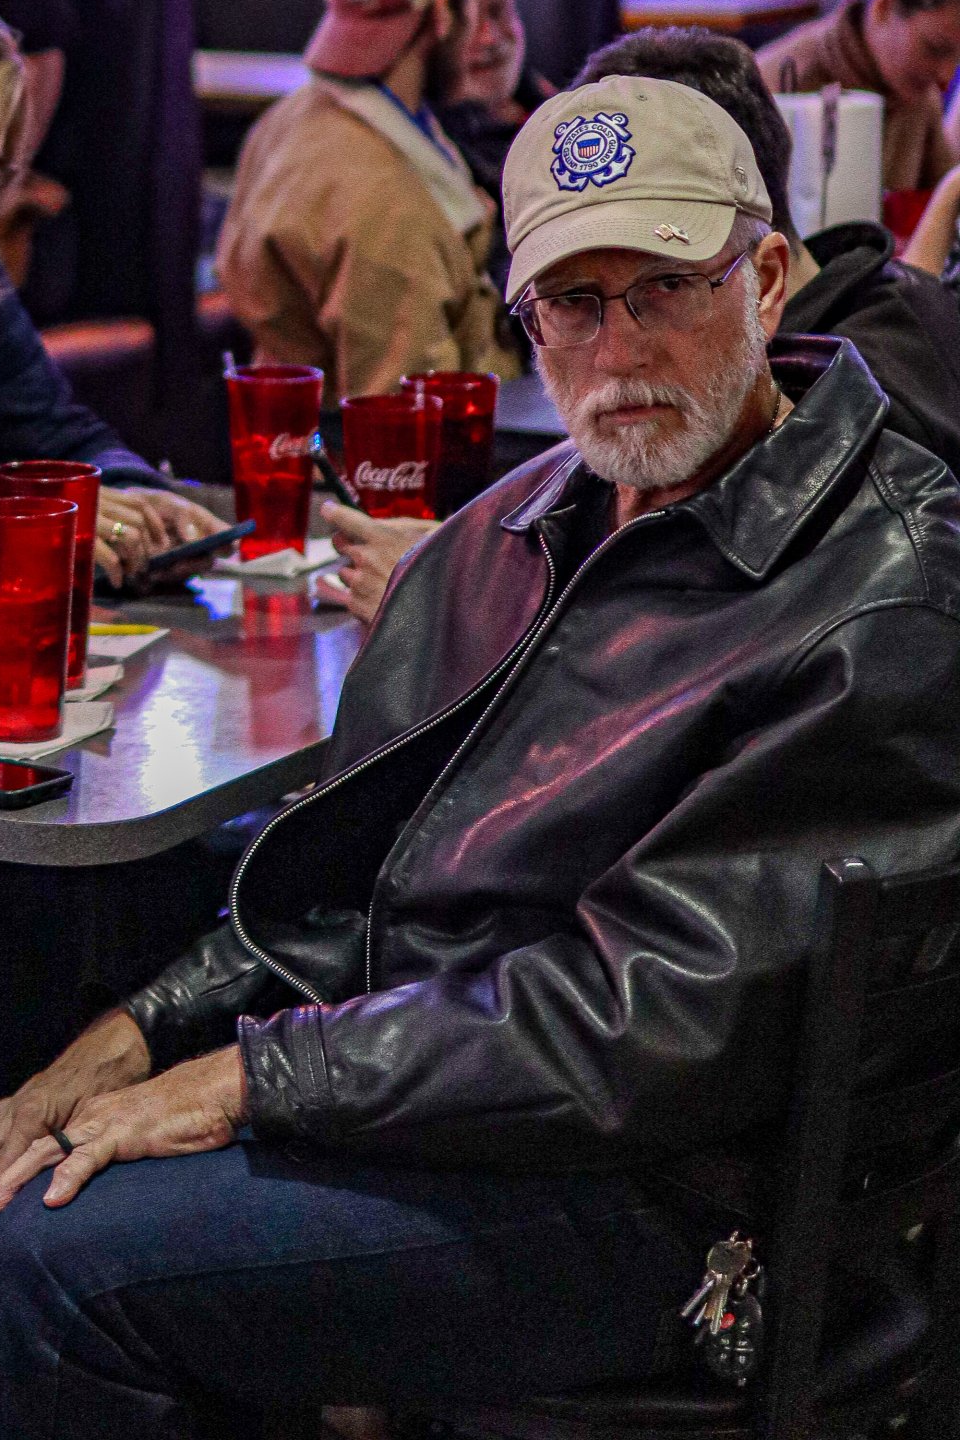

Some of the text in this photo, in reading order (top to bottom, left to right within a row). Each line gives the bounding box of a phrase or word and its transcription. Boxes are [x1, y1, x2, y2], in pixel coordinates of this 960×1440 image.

[563, 123, 617, 170] UNITED STATES COAST GUARD
[579, 161, 599, 171] 1790
